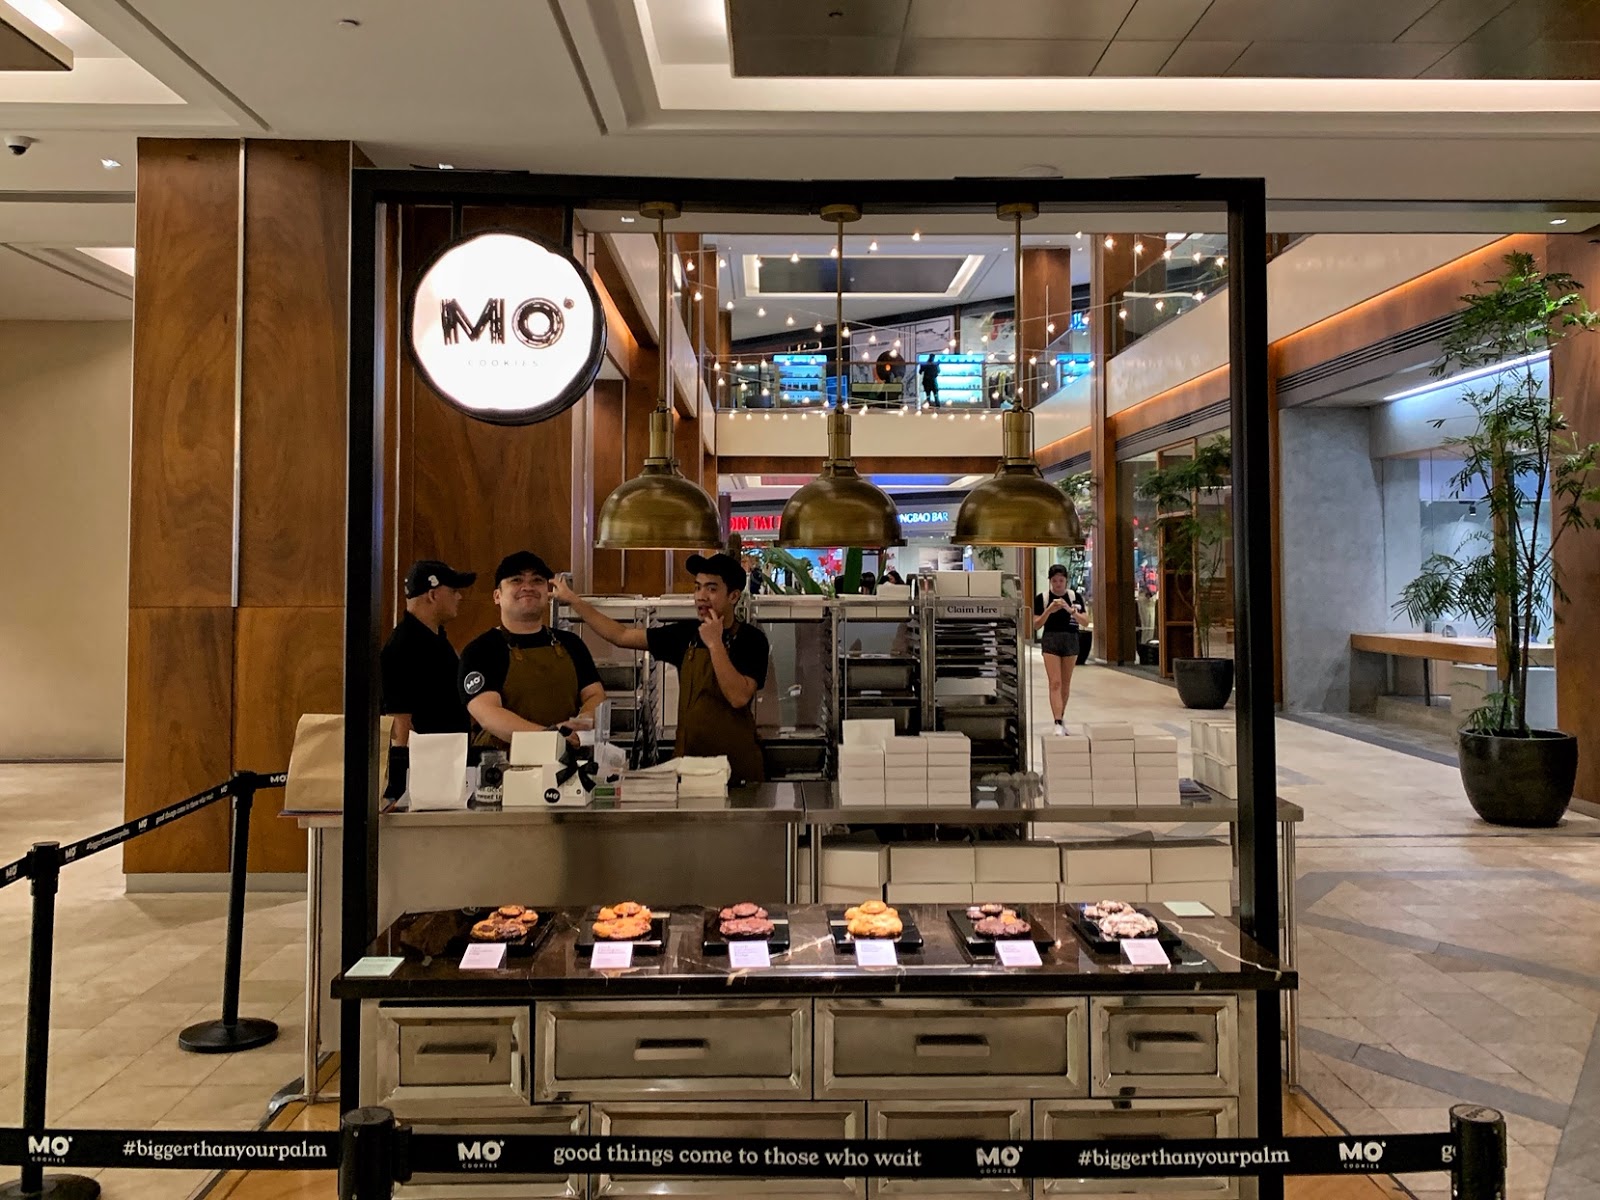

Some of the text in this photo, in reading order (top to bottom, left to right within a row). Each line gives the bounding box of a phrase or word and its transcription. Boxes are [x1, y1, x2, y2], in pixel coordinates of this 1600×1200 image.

[931, 511, 949, 522] BAR
[947, 605, 998, 614] Claim Here
[122, 1139, 327, 1161] #biggerthanyourpalm
[553, 1142, 601, 1165] good
[607, 1143, 674, 1166] things
[679, 1149, 733, 1163] come
[738, 1146, 759, 1165] to
[764, 1147, 820, 1166] those
[825, 1147, 869, 1166] who
[874, 1147, 922, 1167] wait
[1078, 1145, 1291, 1169] #biggerthanyourpalm
